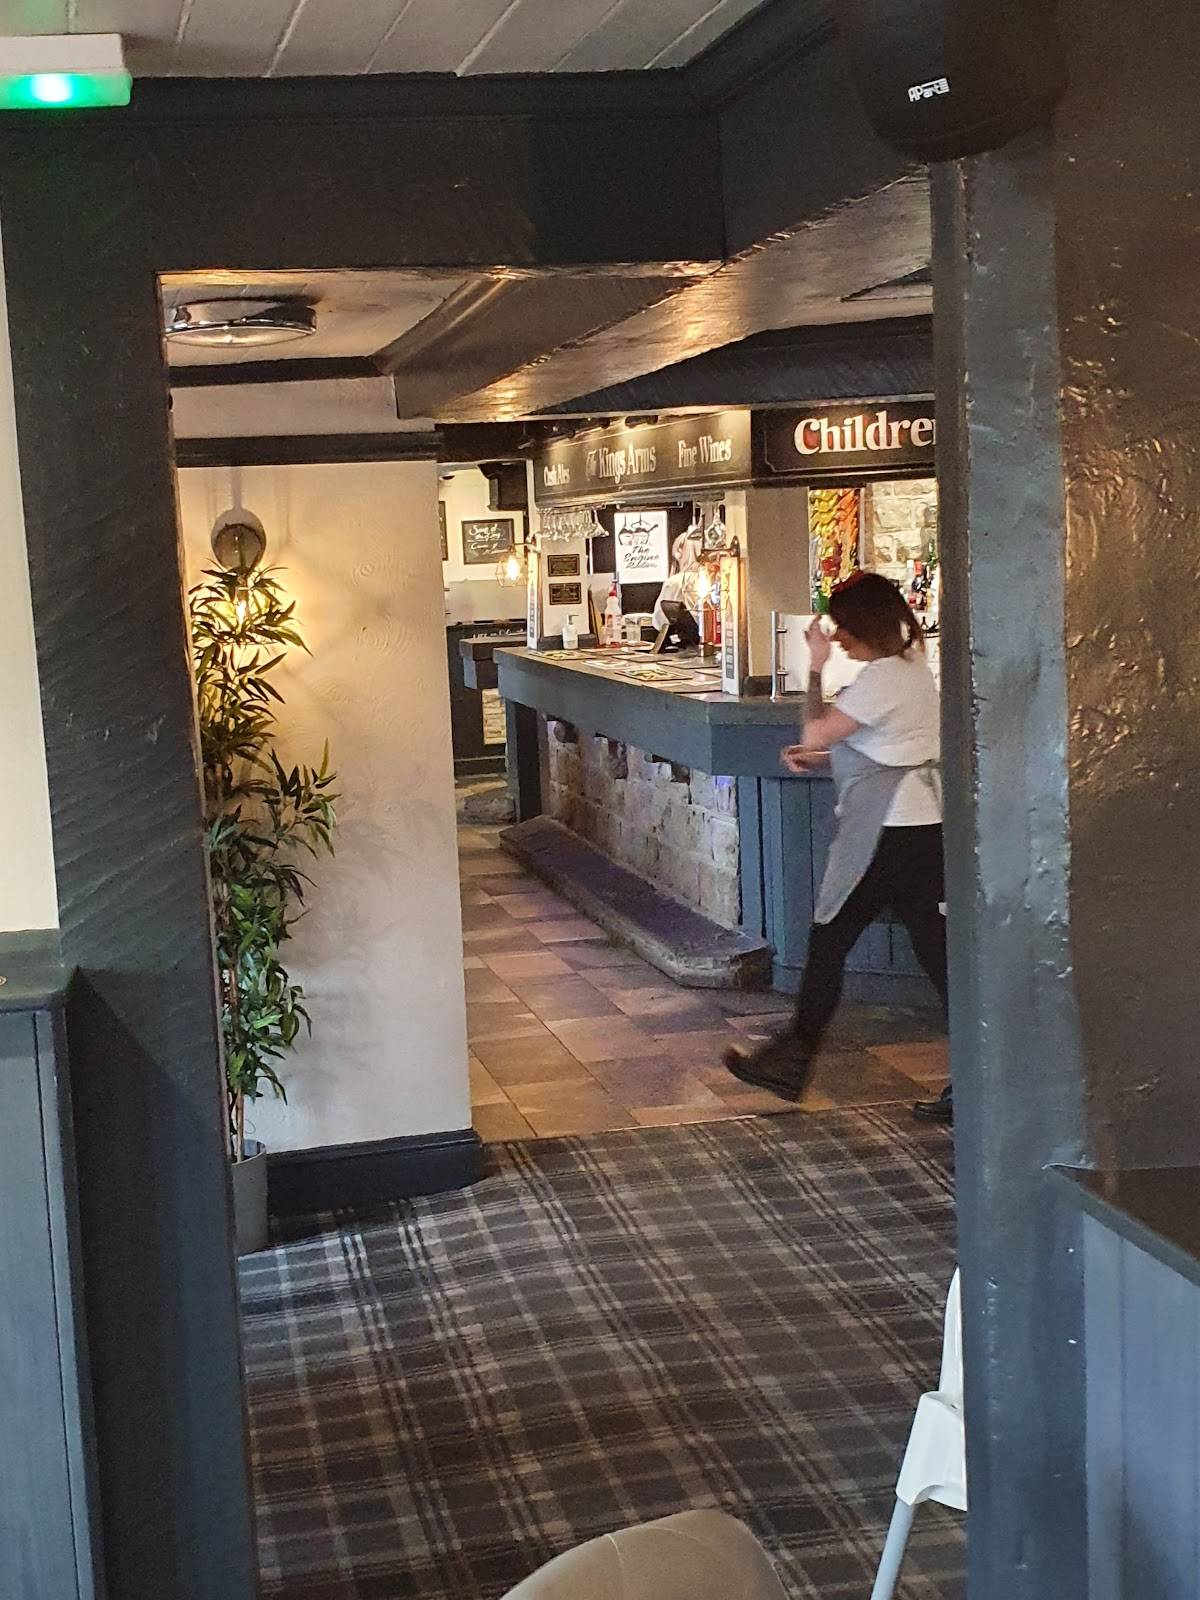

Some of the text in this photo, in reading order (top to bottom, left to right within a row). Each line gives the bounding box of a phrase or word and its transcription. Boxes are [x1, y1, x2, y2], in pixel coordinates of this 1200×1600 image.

[678, 435, 731, 468] Fine Wines
[794, 410, 936, 455] Childre
[599, 447, 626, 484] Kings
[627, 443, 656, 475] Arms
